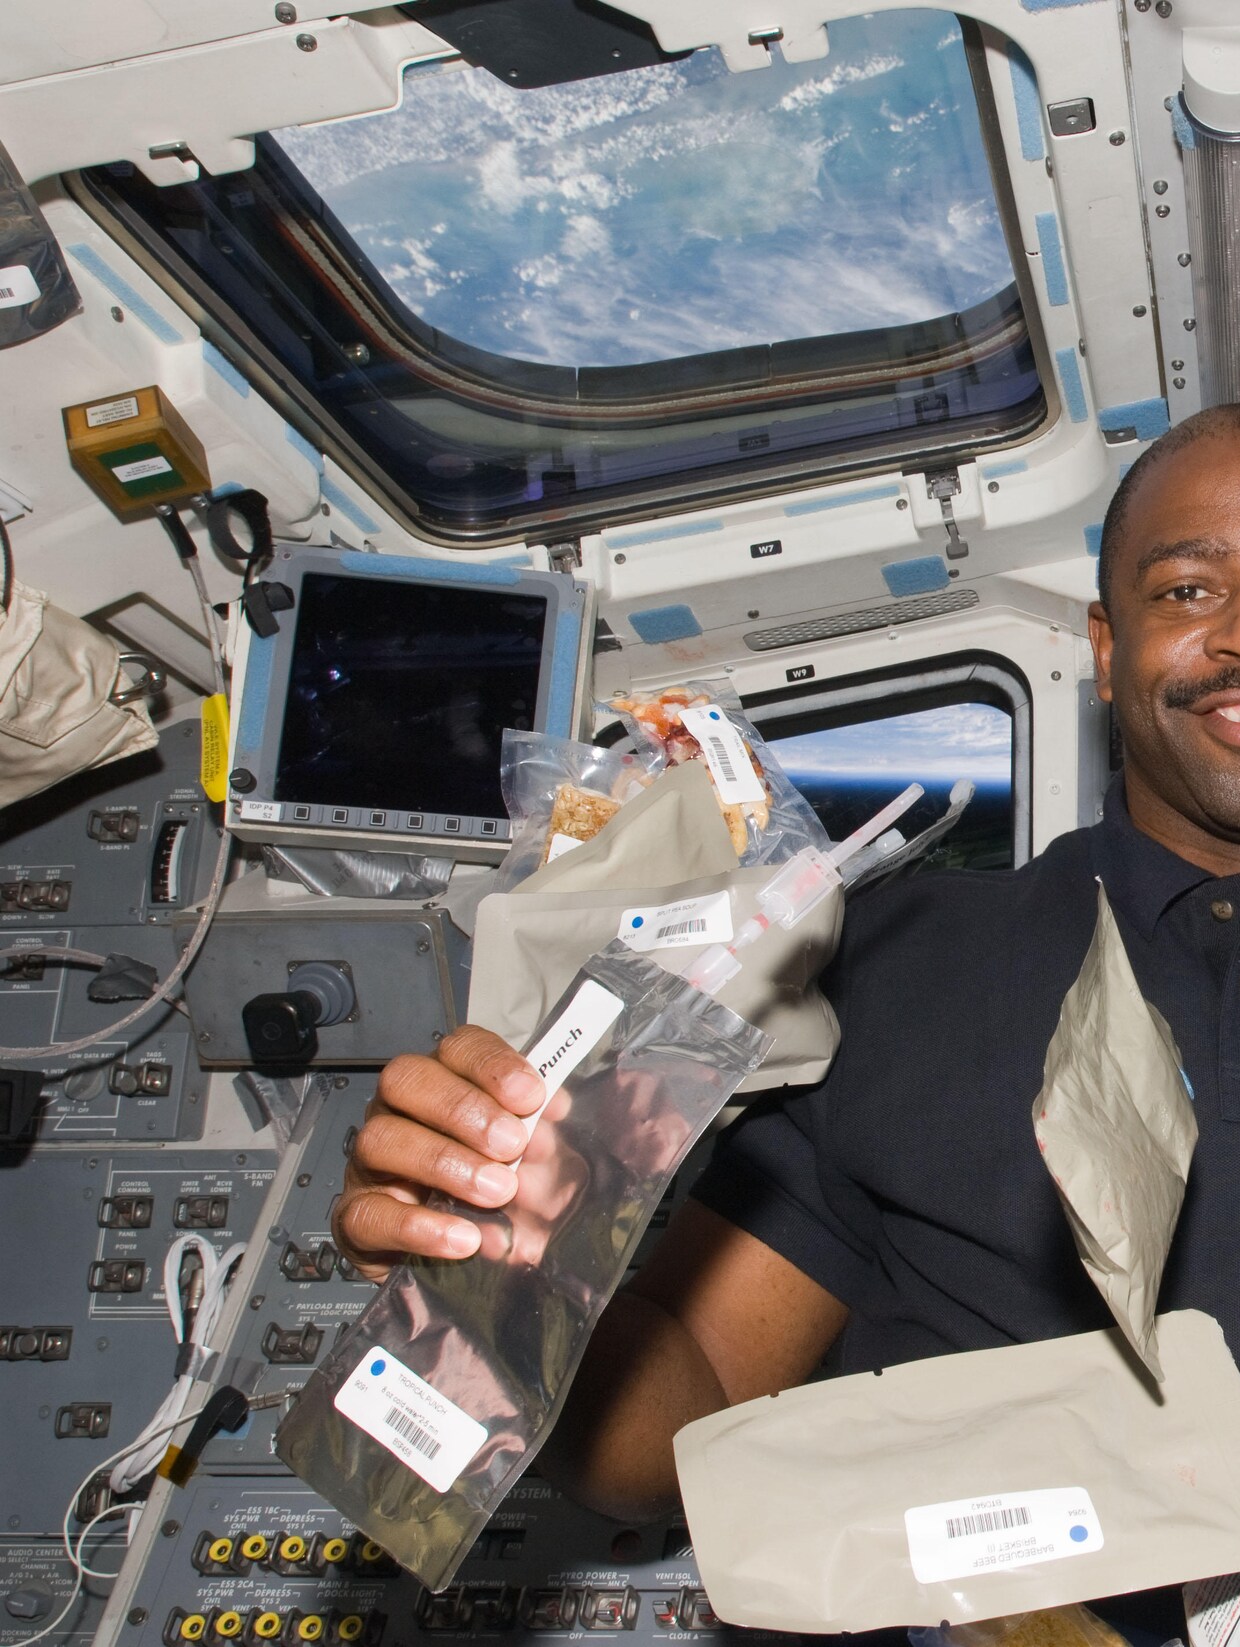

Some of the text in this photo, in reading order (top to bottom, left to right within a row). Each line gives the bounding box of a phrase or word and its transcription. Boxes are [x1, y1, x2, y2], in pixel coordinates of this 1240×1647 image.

[758, 544, 774, 554] W7
[792, 668, 807, 678] W9
[538, 1028, 583, 1078] Punch
[354, 1380, 369, 1392] 9091
[398, 1373, 448, 1416] TROPICAL PUNCH
[495, 1513, 526, 1521] POWER
[999, 1537, 1037, 1552] BRISKET
[8, 1548, 64, 1556] AUDIO CENTER
[972, 1544, 1055, 1568] BARBEQUED BEEF
[656, 1572, 691, 1580] VENT ISOL
[220, 1580, 254, 1588] ESS 2CA
[255, 1589, 292, 1597] DEPRESS
[569, 1632, 583, 1640] OFF
[669, 1632, 691, 1640] CLOSE
